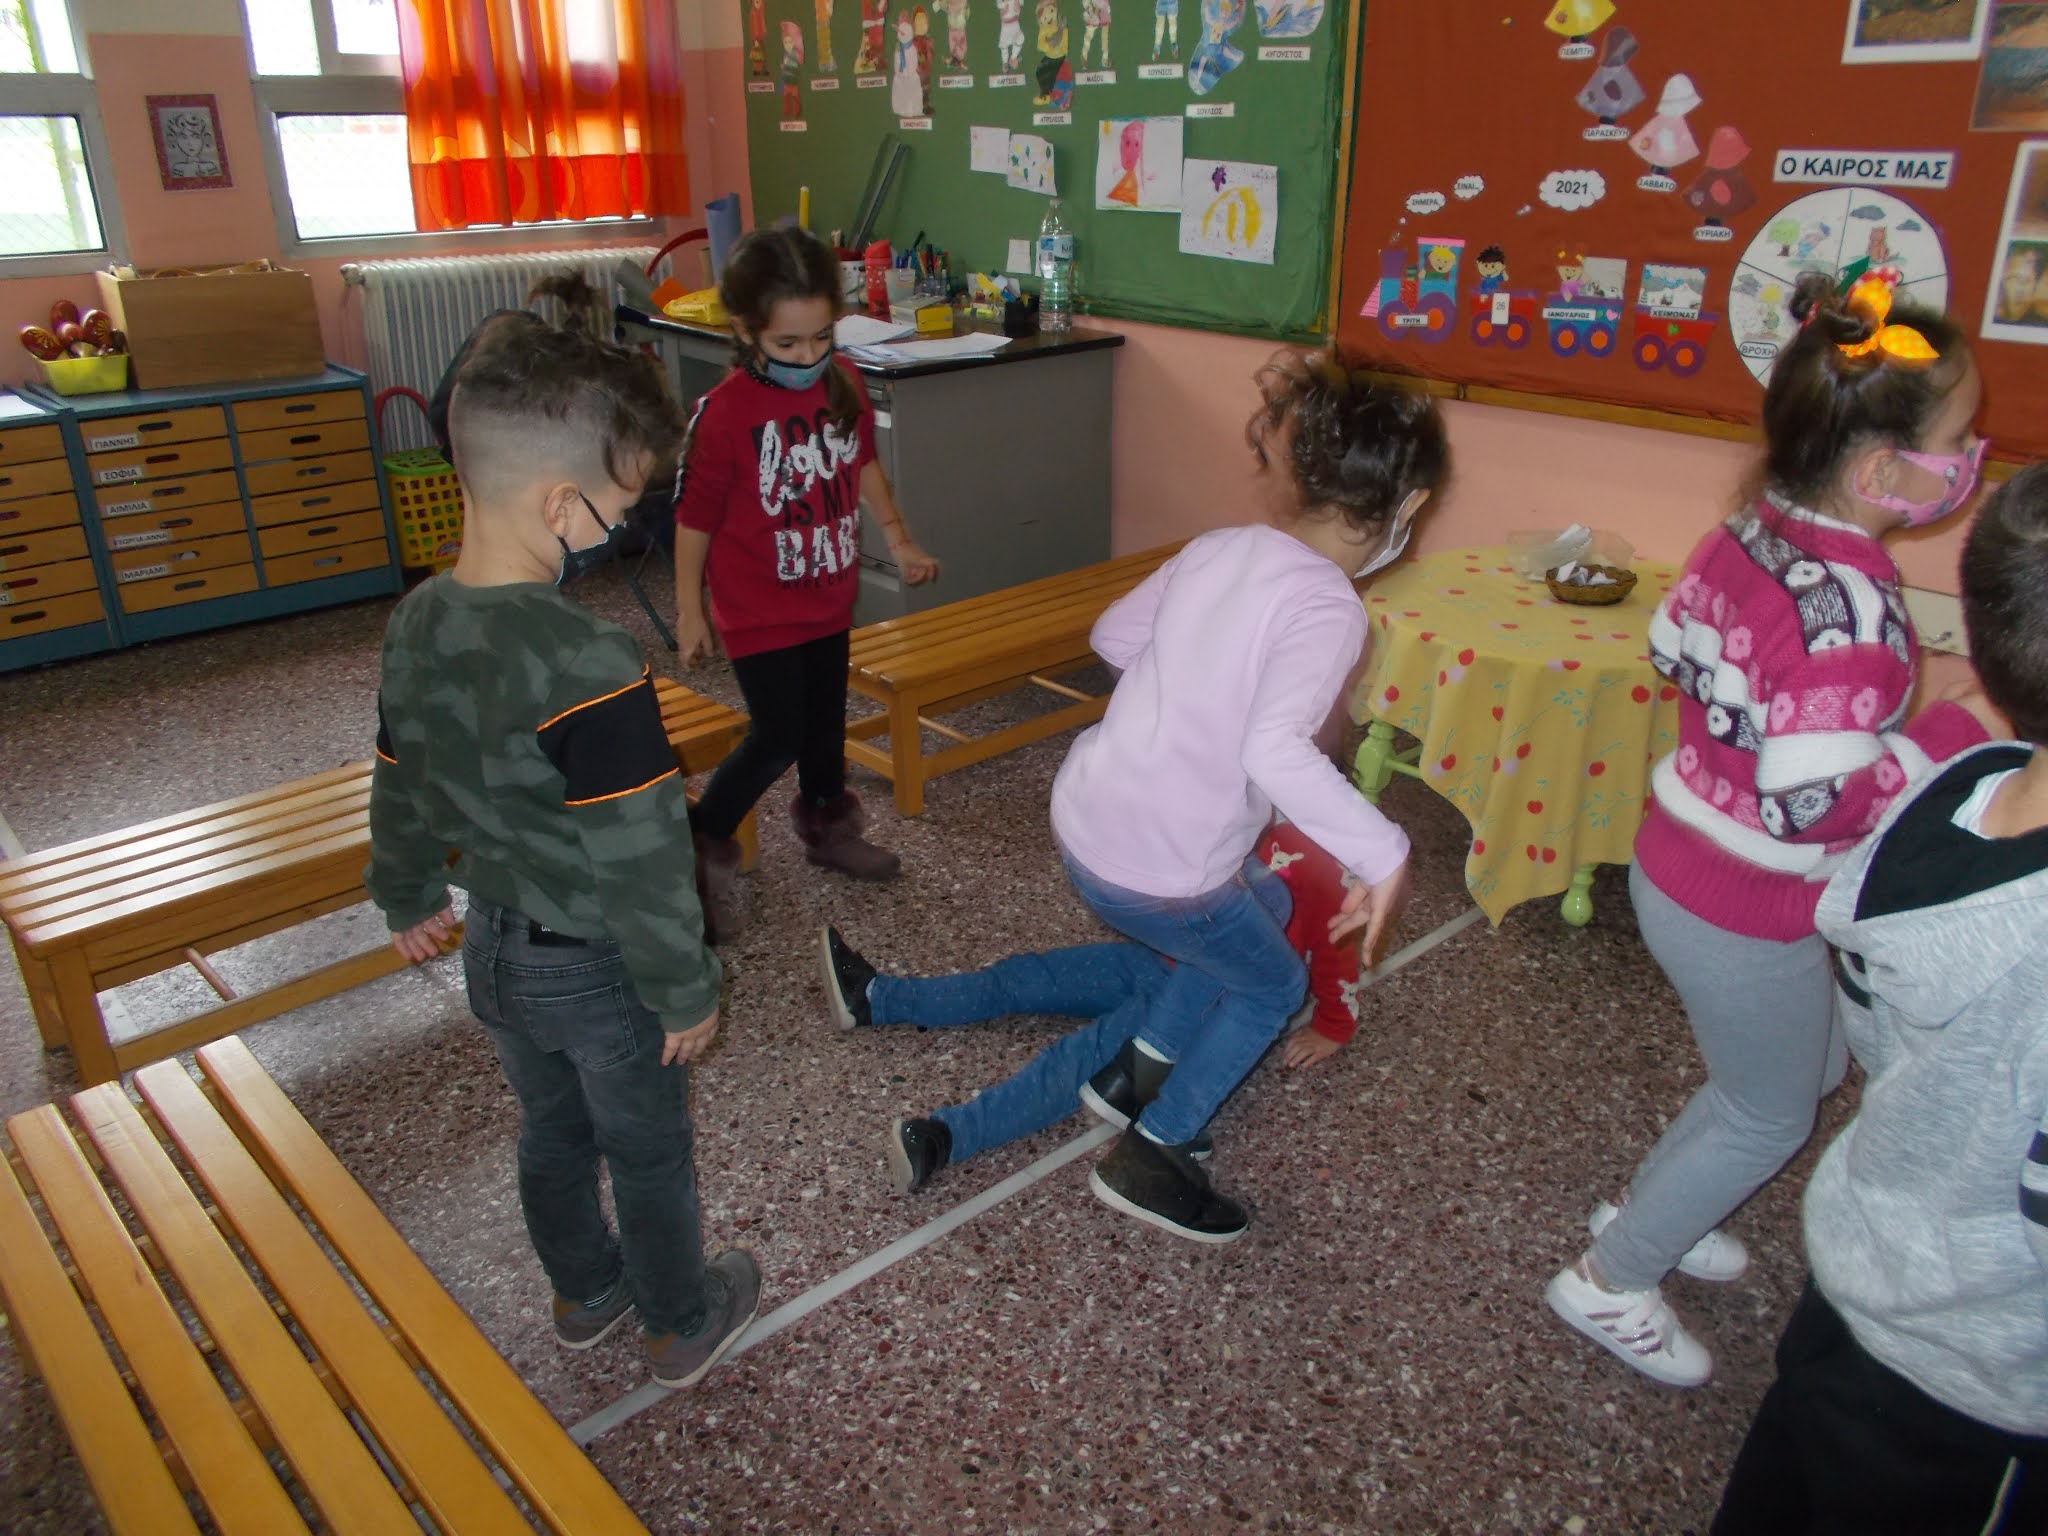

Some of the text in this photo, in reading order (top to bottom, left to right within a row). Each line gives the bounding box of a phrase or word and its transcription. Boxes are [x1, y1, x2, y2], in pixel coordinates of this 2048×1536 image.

[1265, 50, 1302, 59] ΑΥΓΟΥΣΤΟΣ
[1583, 128, 1629, 138] ΠΑΡΑΣΚΕΥΗ
[1781, 157, 1948, 180] Ο ΚΑΙΡΟΣ ΜΑΣ
[1555, 180, 1588, 195] 2021
[1638, 178, 1675, 190] ΣΑΒΒΑΤΟ
[1695, 229, 1731, 238] ΚΥΡΙΑΚΗ
[1496, 301, 1506, 310] 26
[1402, 317, 1421, 325] ΤΡΙΤΗ
[1742, 345, 1775, 356] ΒΡΟΧΗ
[94, 436, 137, 449] ΓΙΑΝΝΗΣ
[104, 467, 138, 480] ΣΟΦΙΑ
[109, 502, 148, 514] ΑΙΜΙΛΙΑ
[774, 510, 859, 580] BAB
